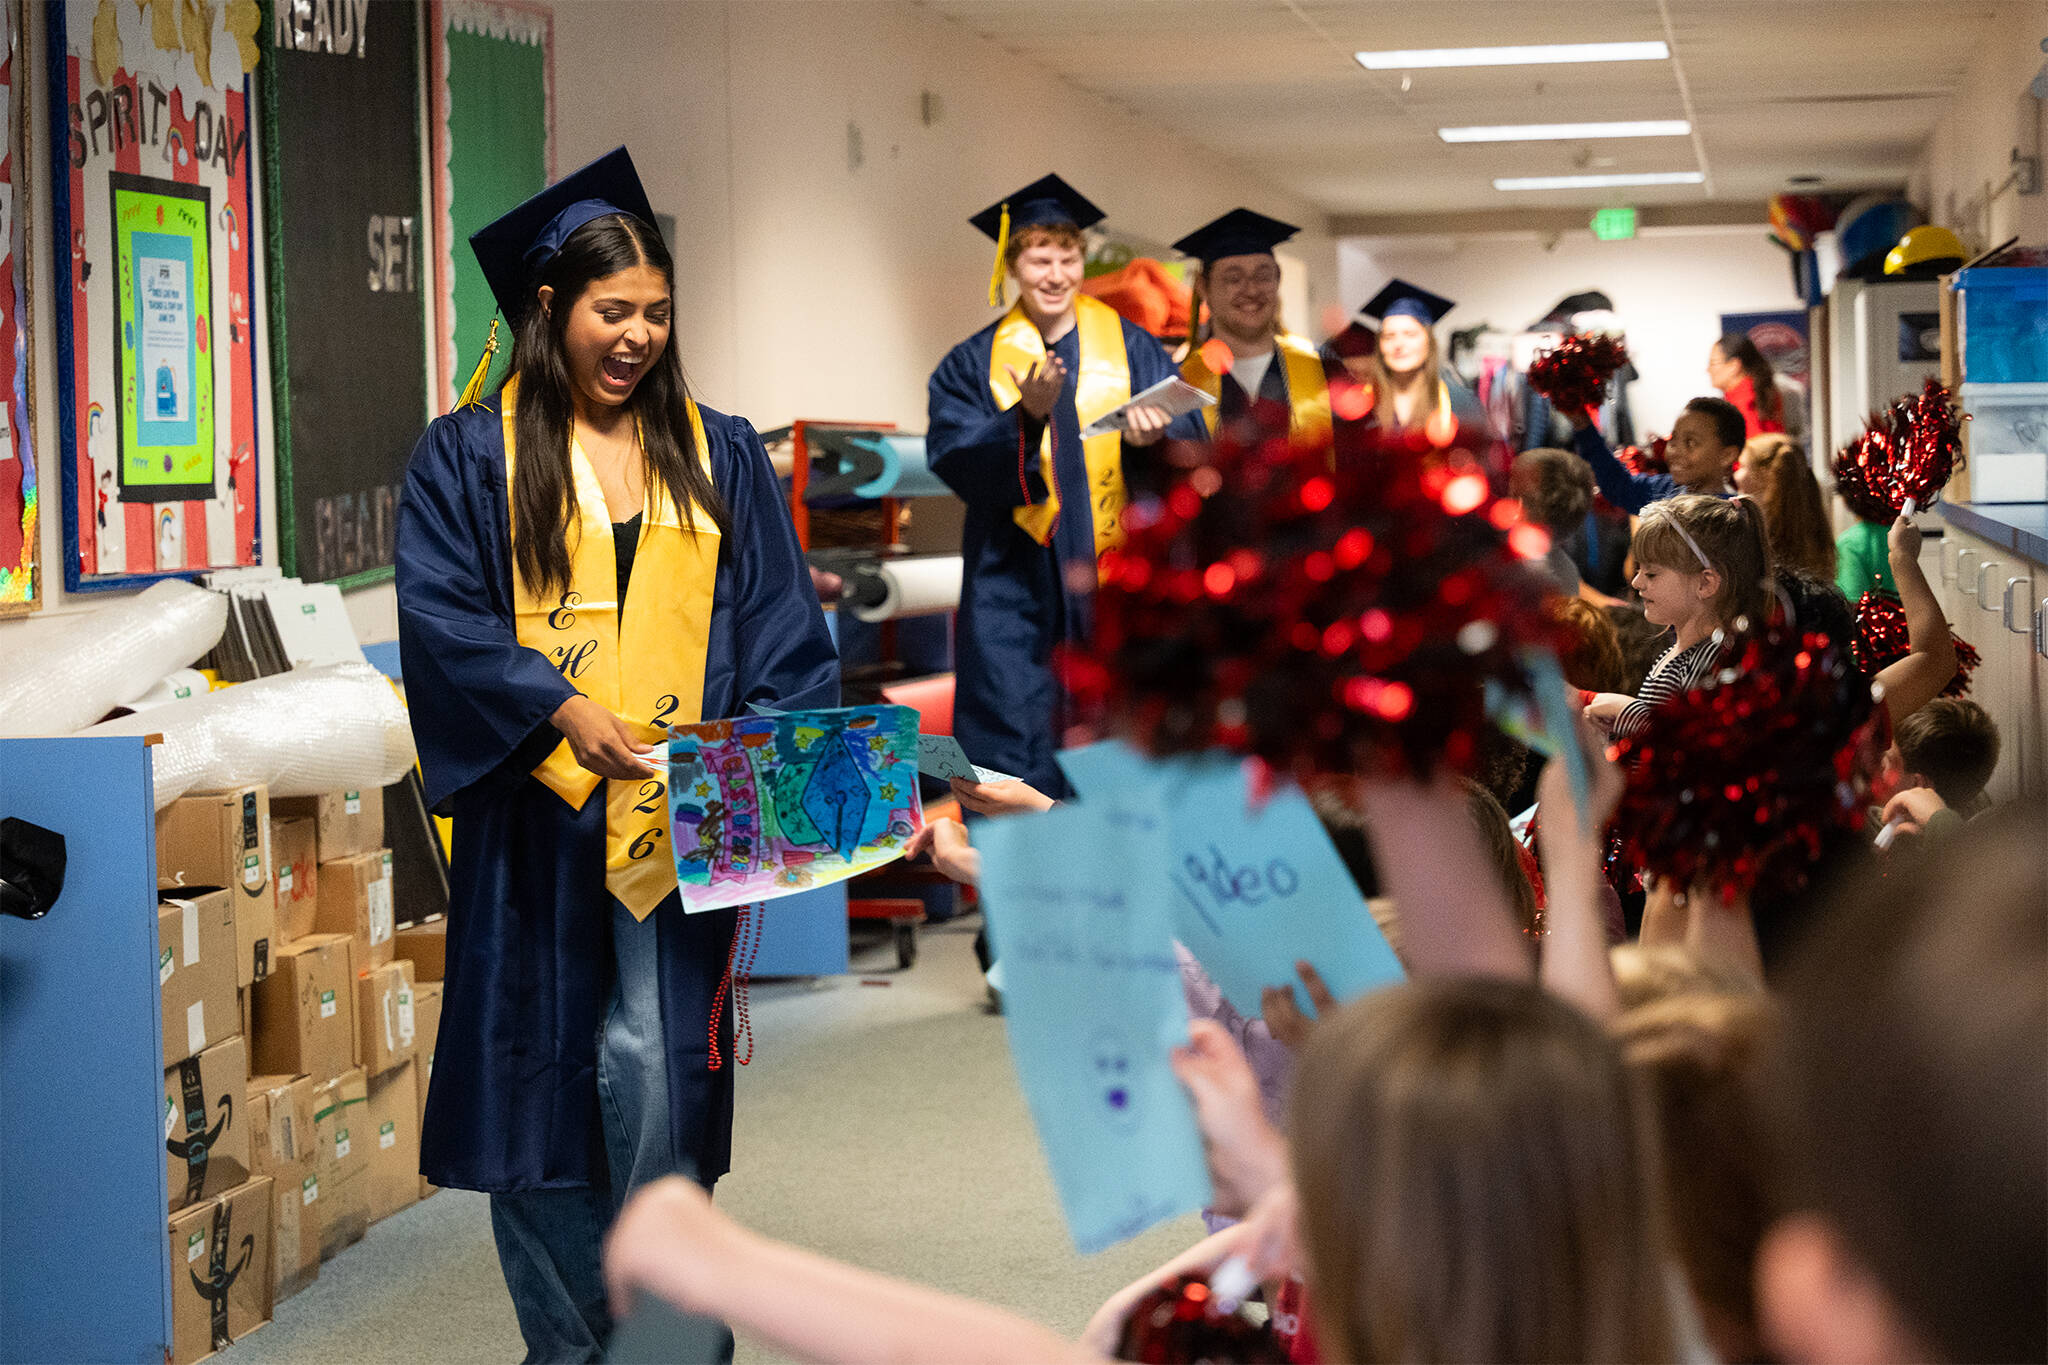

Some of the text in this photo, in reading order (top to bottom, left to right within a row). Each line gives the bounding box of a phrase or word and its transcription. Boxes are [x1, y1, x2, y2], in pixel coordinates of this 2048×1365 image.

[69, 81, 247, 178] SPIRIT DAY
[368, 216, 414, 292] SET
[315, 486, 402, 577] READ
[722, 756, 753, 872] CLASS OF 2026
